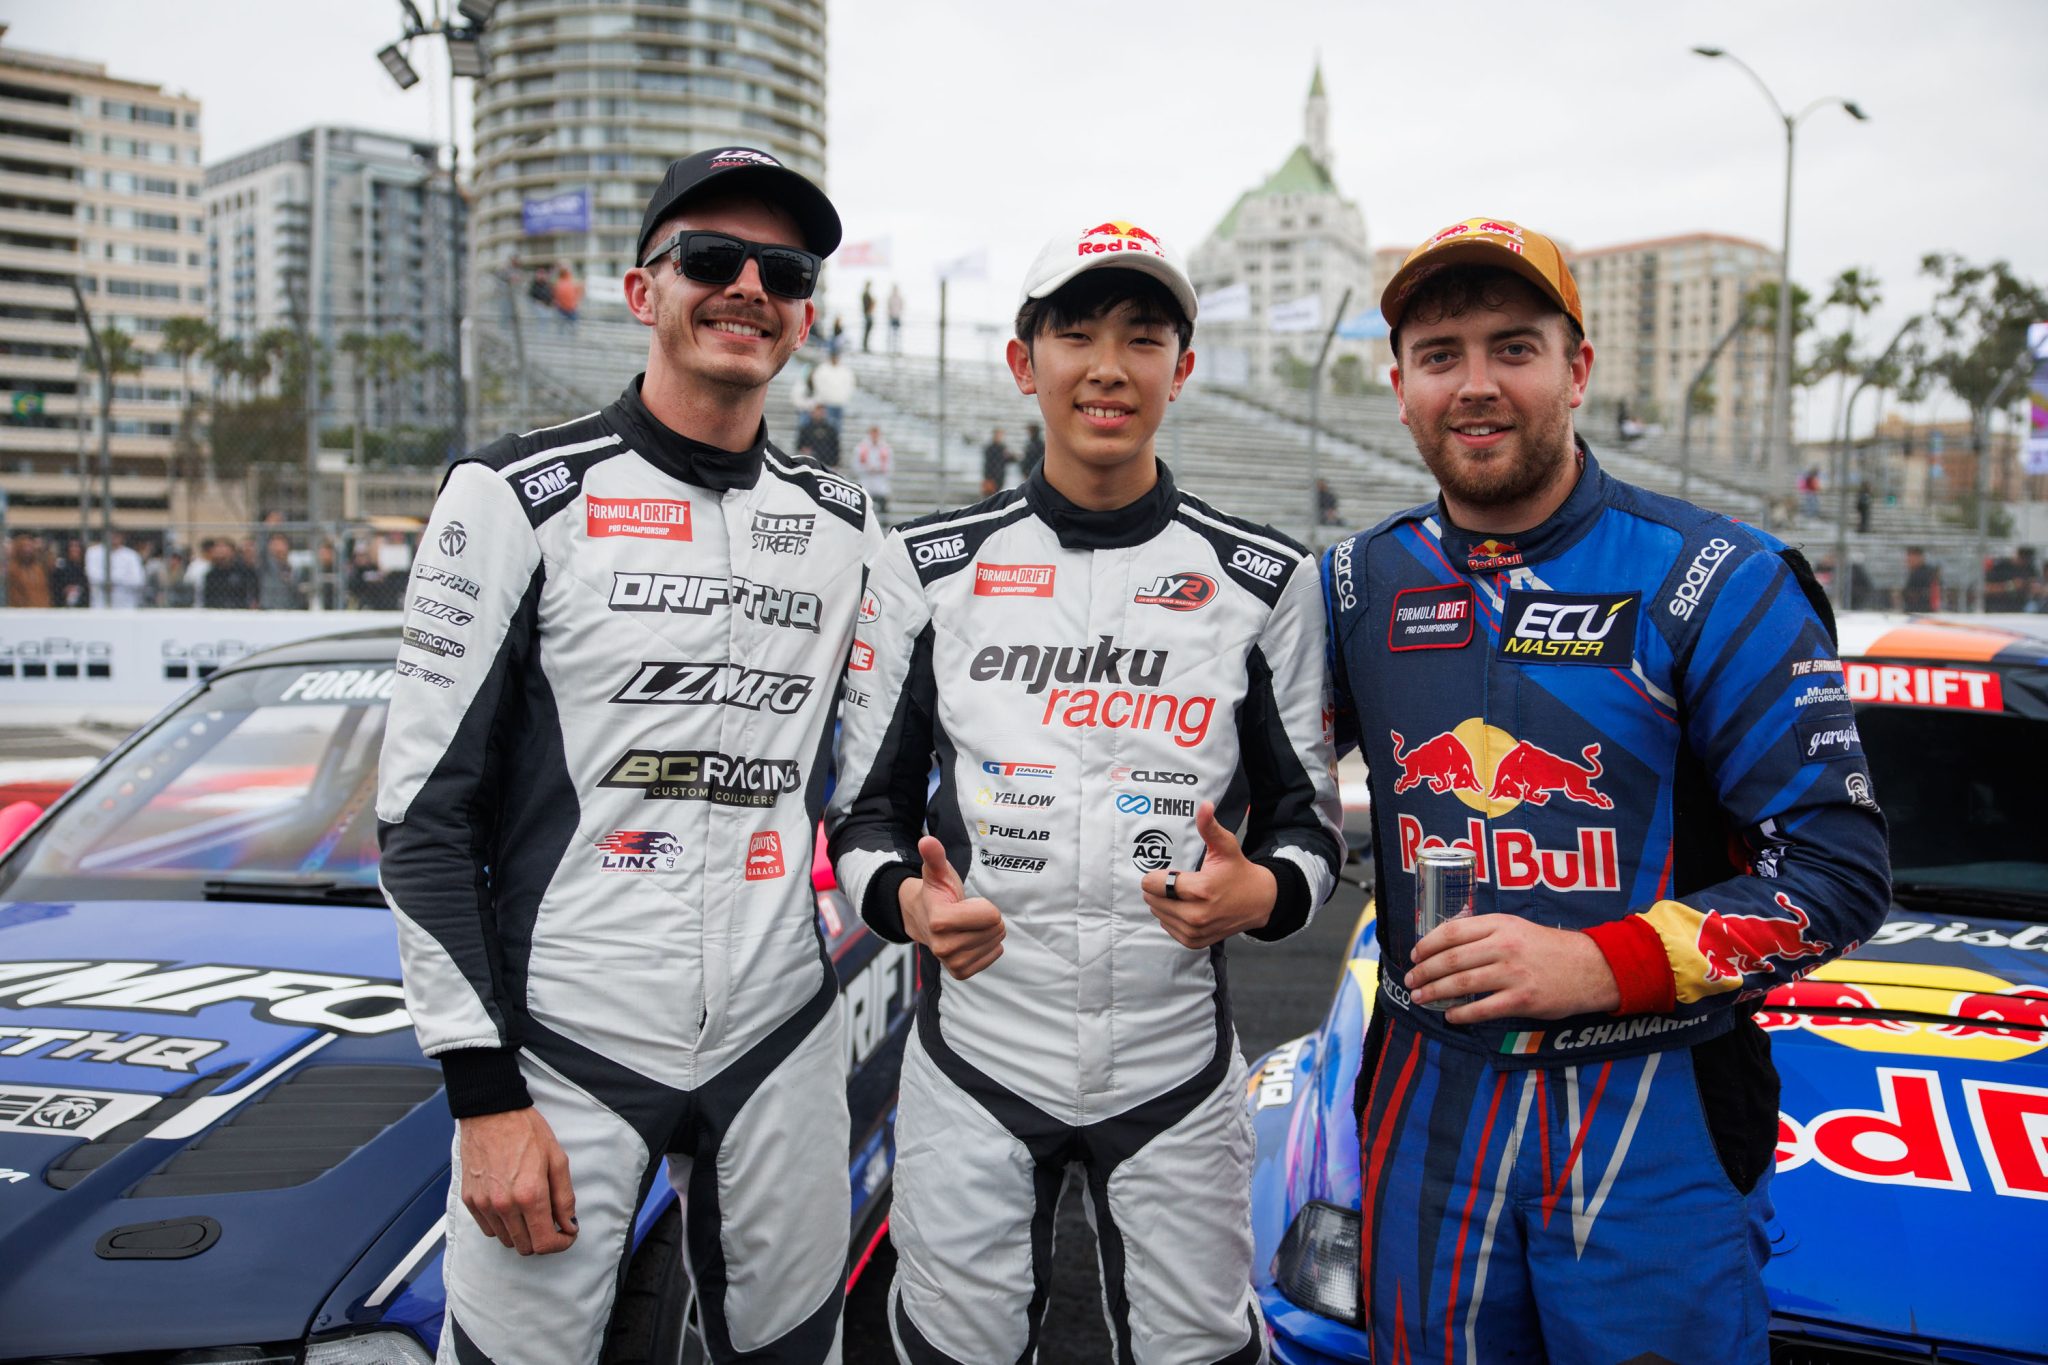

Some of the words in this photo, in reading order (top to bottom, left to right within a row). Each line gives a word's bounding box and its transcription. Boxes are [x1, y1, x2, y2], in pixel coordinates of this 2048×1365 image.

[1078, 239, 1122, 256] Red
[524, 466, 572, 500] OMP
[819, 481, 861, 507] OMP
[588, 502, 640, 520] FORMULA
[642, 503, 685, 524] DRIFT
[608, 524, 621, 533] PRO
[622, 524, 669, 536] CHAMPIONSHIP
[751, 533, 810, 556] STREETS
[915, 538, 965, 564] OMP
[1232, 549, 1283, 579] OMP
[1467, 558, 1494, 570] Red
[1494, 553, 1522, 567] Bull
[977, 567, 1018, 582] FORMULA
[1017, 567, 1050, 584] DRIFT
[1337, 537, 1358, 612] sparco
[1669, 538, 1736, 620] sparco
[608, 572, 823, 634] DRIFTHQ
[1396, 606, 1437, 622] FORMULA
[1437, 601, 1467, 619] DRIFT
[1405, 626, 1417, 634] PRO
[1417, 623, 1458, 634] CHAMPIONSHIP
[1515, 598, 1633, 640] ECU
[418, 632, 464, 657] RACING
[1504, 637, 1605, 657] MASTER
[969, 635, 1169, 694] enjuku
[1792, 661, 1812, 676] THE
[611, 663, 814, 711] LZMFG
[1847, 664, 1991, 709] DRIFT
[1041, 688, 1217, 749] racing
[610, 756, 699, 783] BC
[702, 756, 797, 793] RACING
[1016, 767, 1055, 775] RADIAL
[1130, 770, 1199, 786] CUSCO
[652, 786, 709, 798] CUSTOM
[714, 791, 774, 805] COILOVERS
[993, 792, 1056, 807] YELLOW
[1153, 797, 1195, 817] ENKEI
[989, 824, 1051, 841] FUELAB
[602, 856, 659, 869] LINK
[990, 856, 1046, 871] WISEFAB
[1132, 845, 1172, 861] ACL
[1492, 827, 1620, 892] Bull
[748, 866, 780, 876] GARAGE
[840, 942, 914, 1080] RIFT
